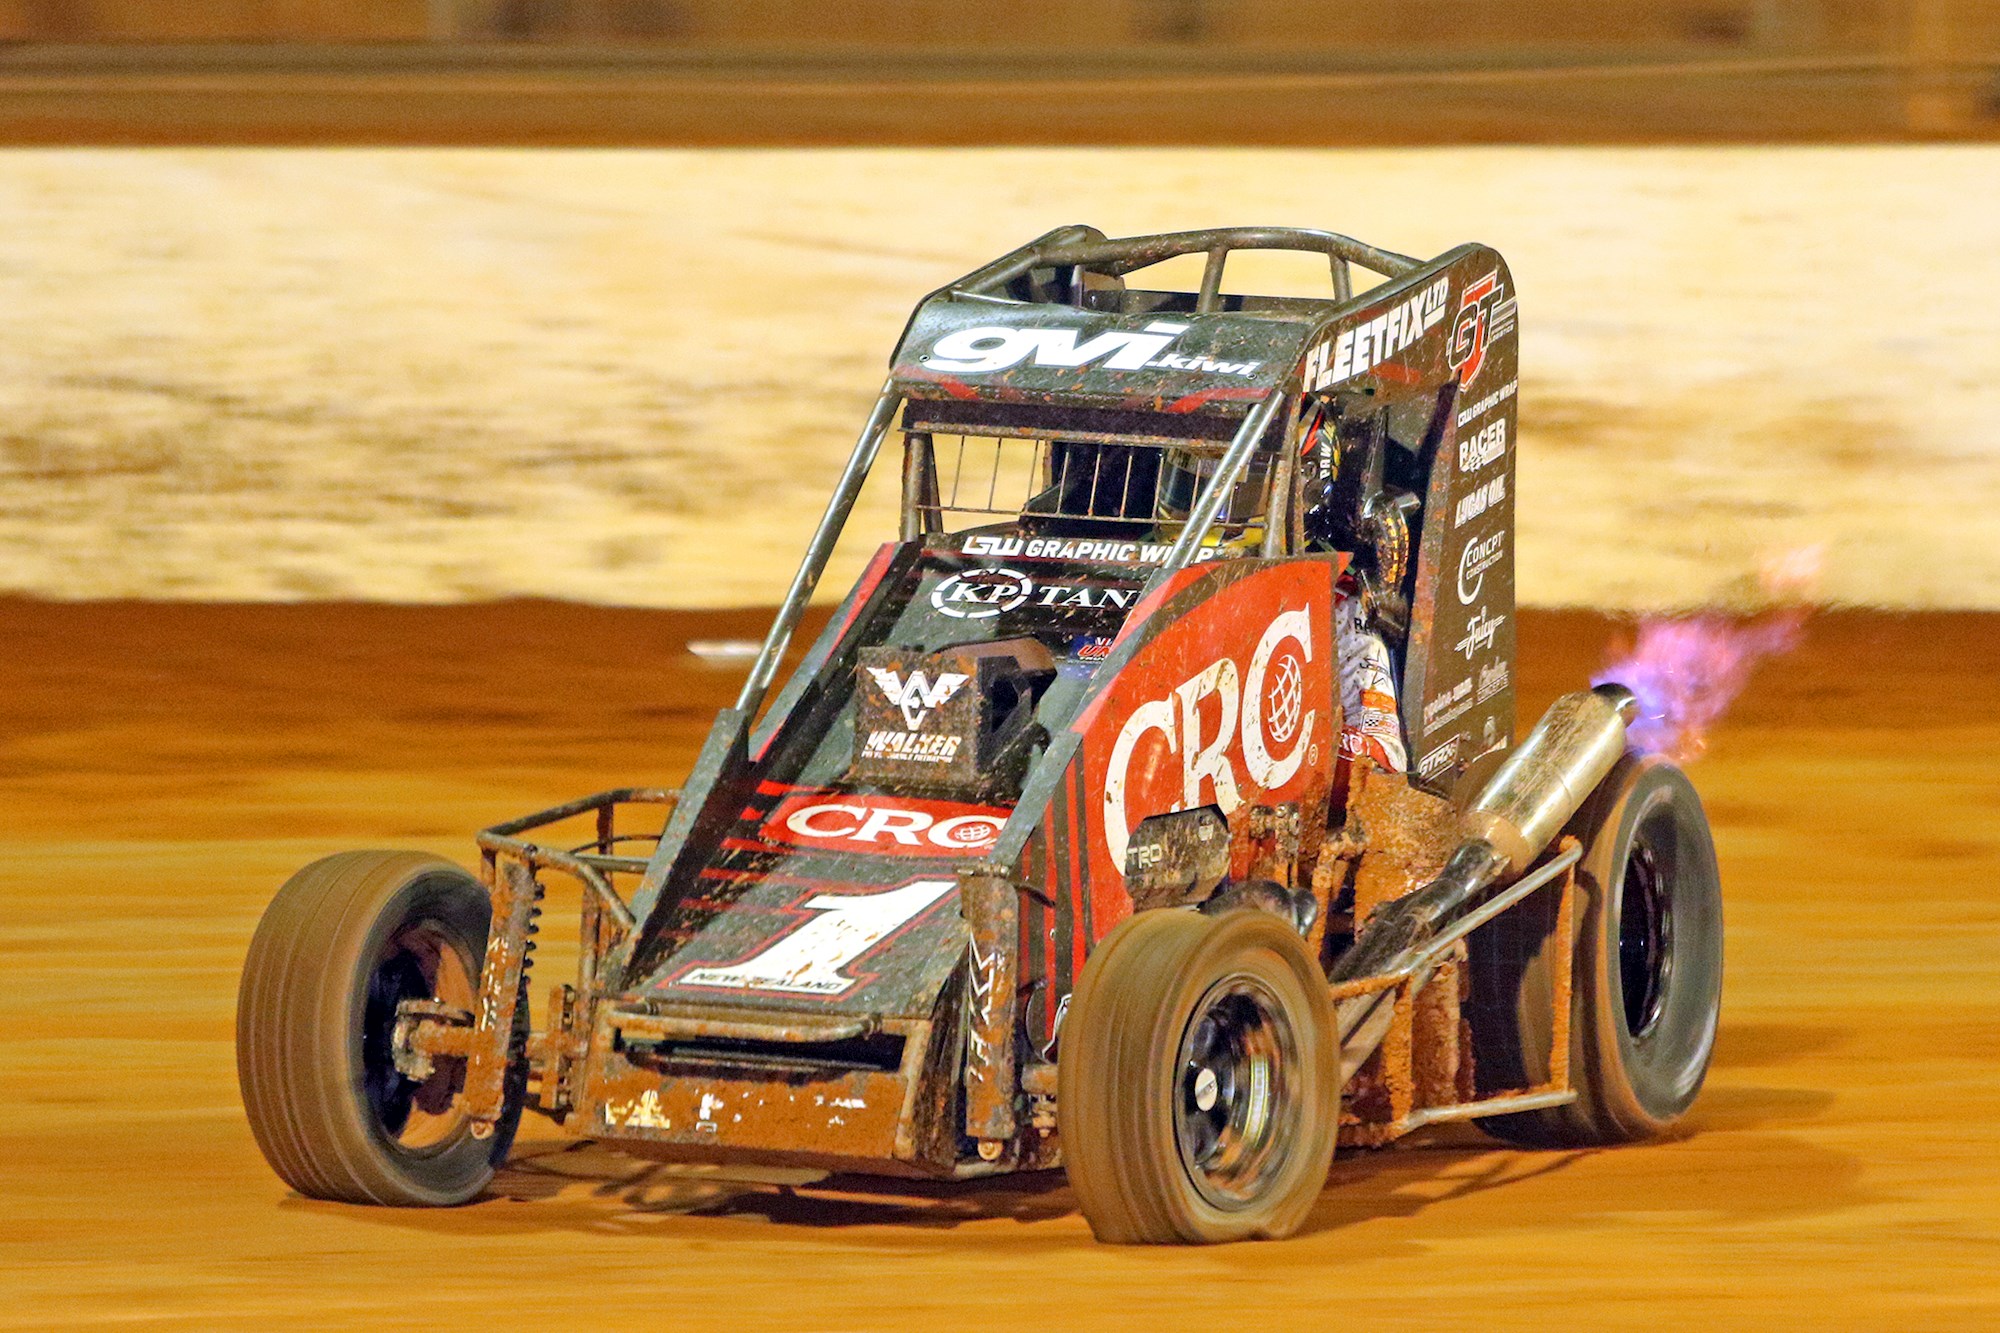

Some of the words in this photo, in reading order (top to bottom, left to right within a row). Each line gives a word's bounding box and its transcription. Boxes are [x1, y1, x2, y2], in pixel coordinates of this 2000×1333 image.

[1302, 289, 1427, 393] FLEETFIX
[1425, 276, 1449, 315] LTD
[1454, 484, 1489, 529] LUCAS
[1488, 473, 1505, 508] OIL
[1025, 539, 1137, 562] GRAPHIC
[945, 582, 1021, 604] KP
[864, 730, 962, 756] WALKER
[1104, 603, 1316, 877] CRC
[787, 804, 1009, 849] CRC
[679, 881, 958, 994] 1
